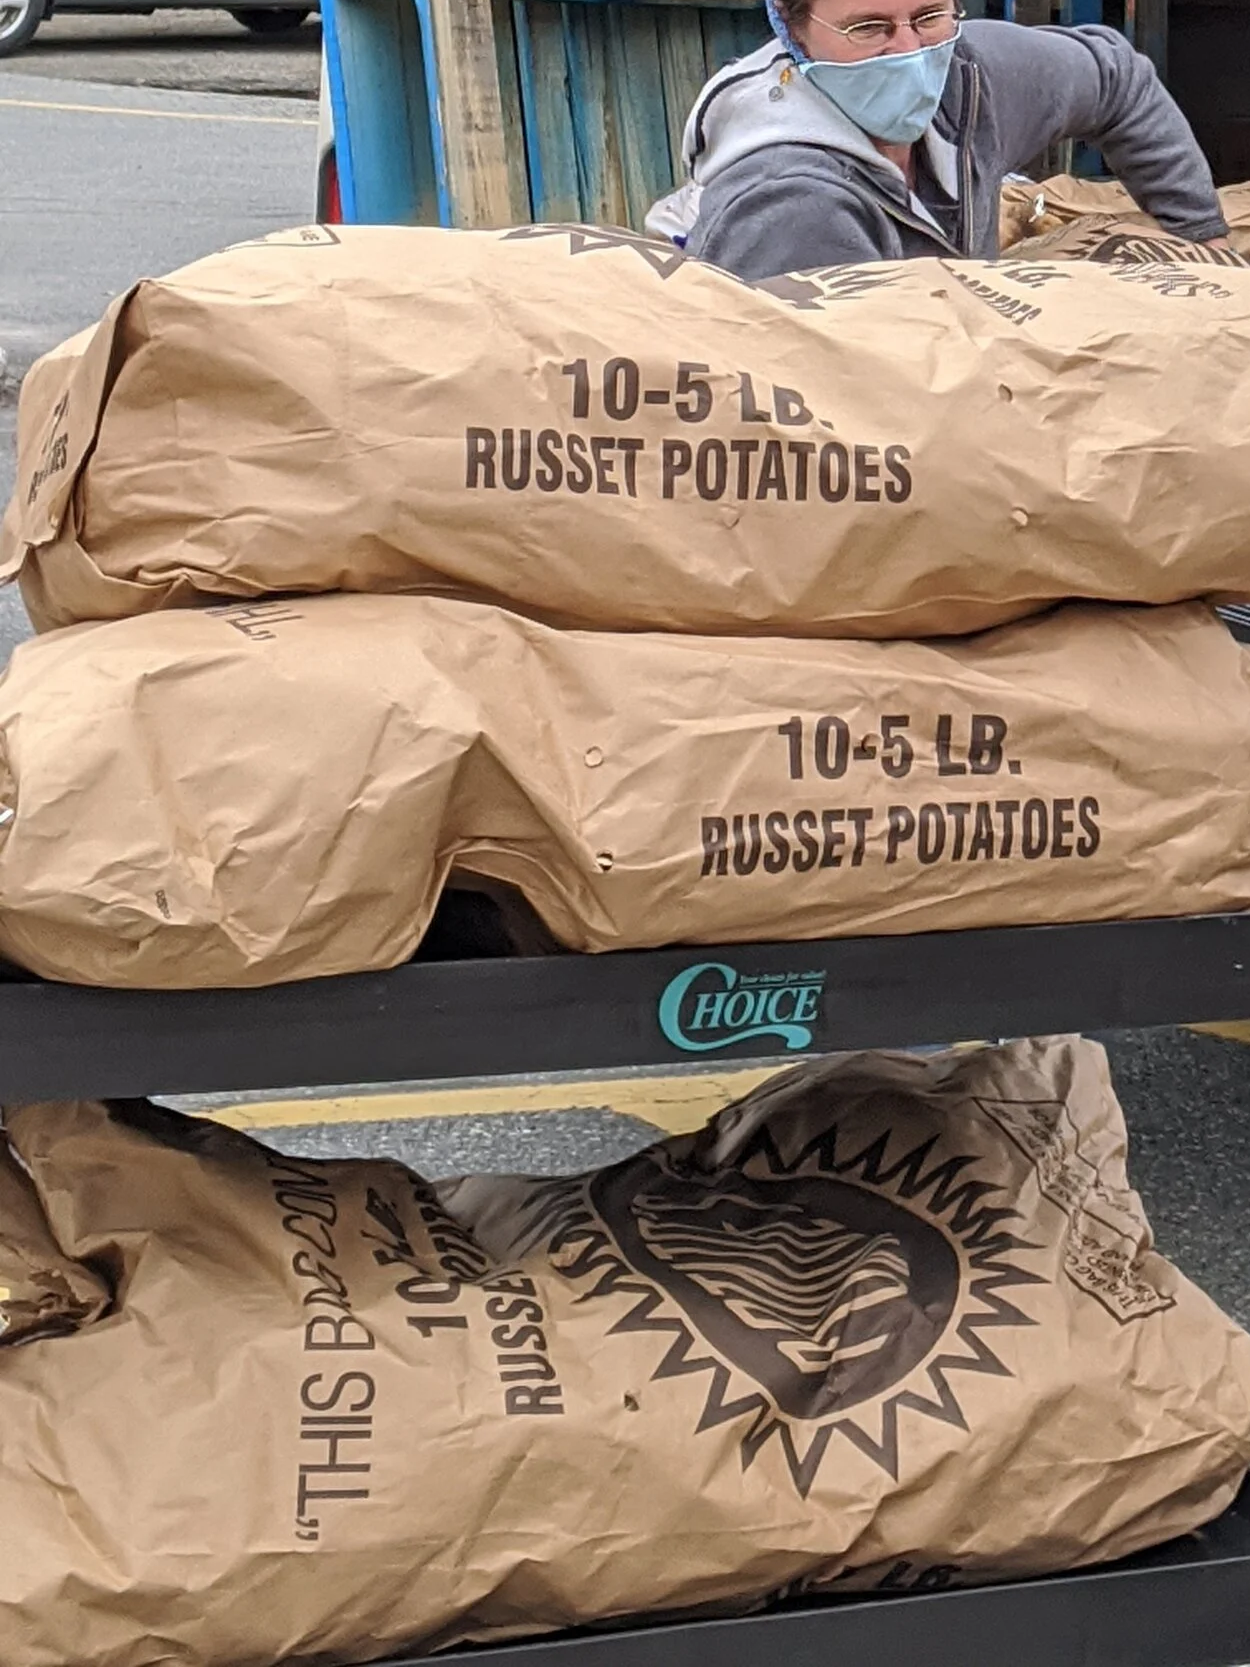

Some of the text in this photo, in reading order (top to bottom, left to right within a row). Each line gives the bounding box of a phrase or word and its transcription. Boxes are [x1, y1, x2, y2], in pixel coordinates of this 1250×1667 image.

[562, 356, 834, 430] 10-5 LB.
[466, 426, 912, 504] RUSSET POTATOES
[778, 714, 1023, 780] 10-5 LB.
[700, 795, 1101, 877] RUSSET POTATOES
[659, 962, 822, 1051] CHOICE
